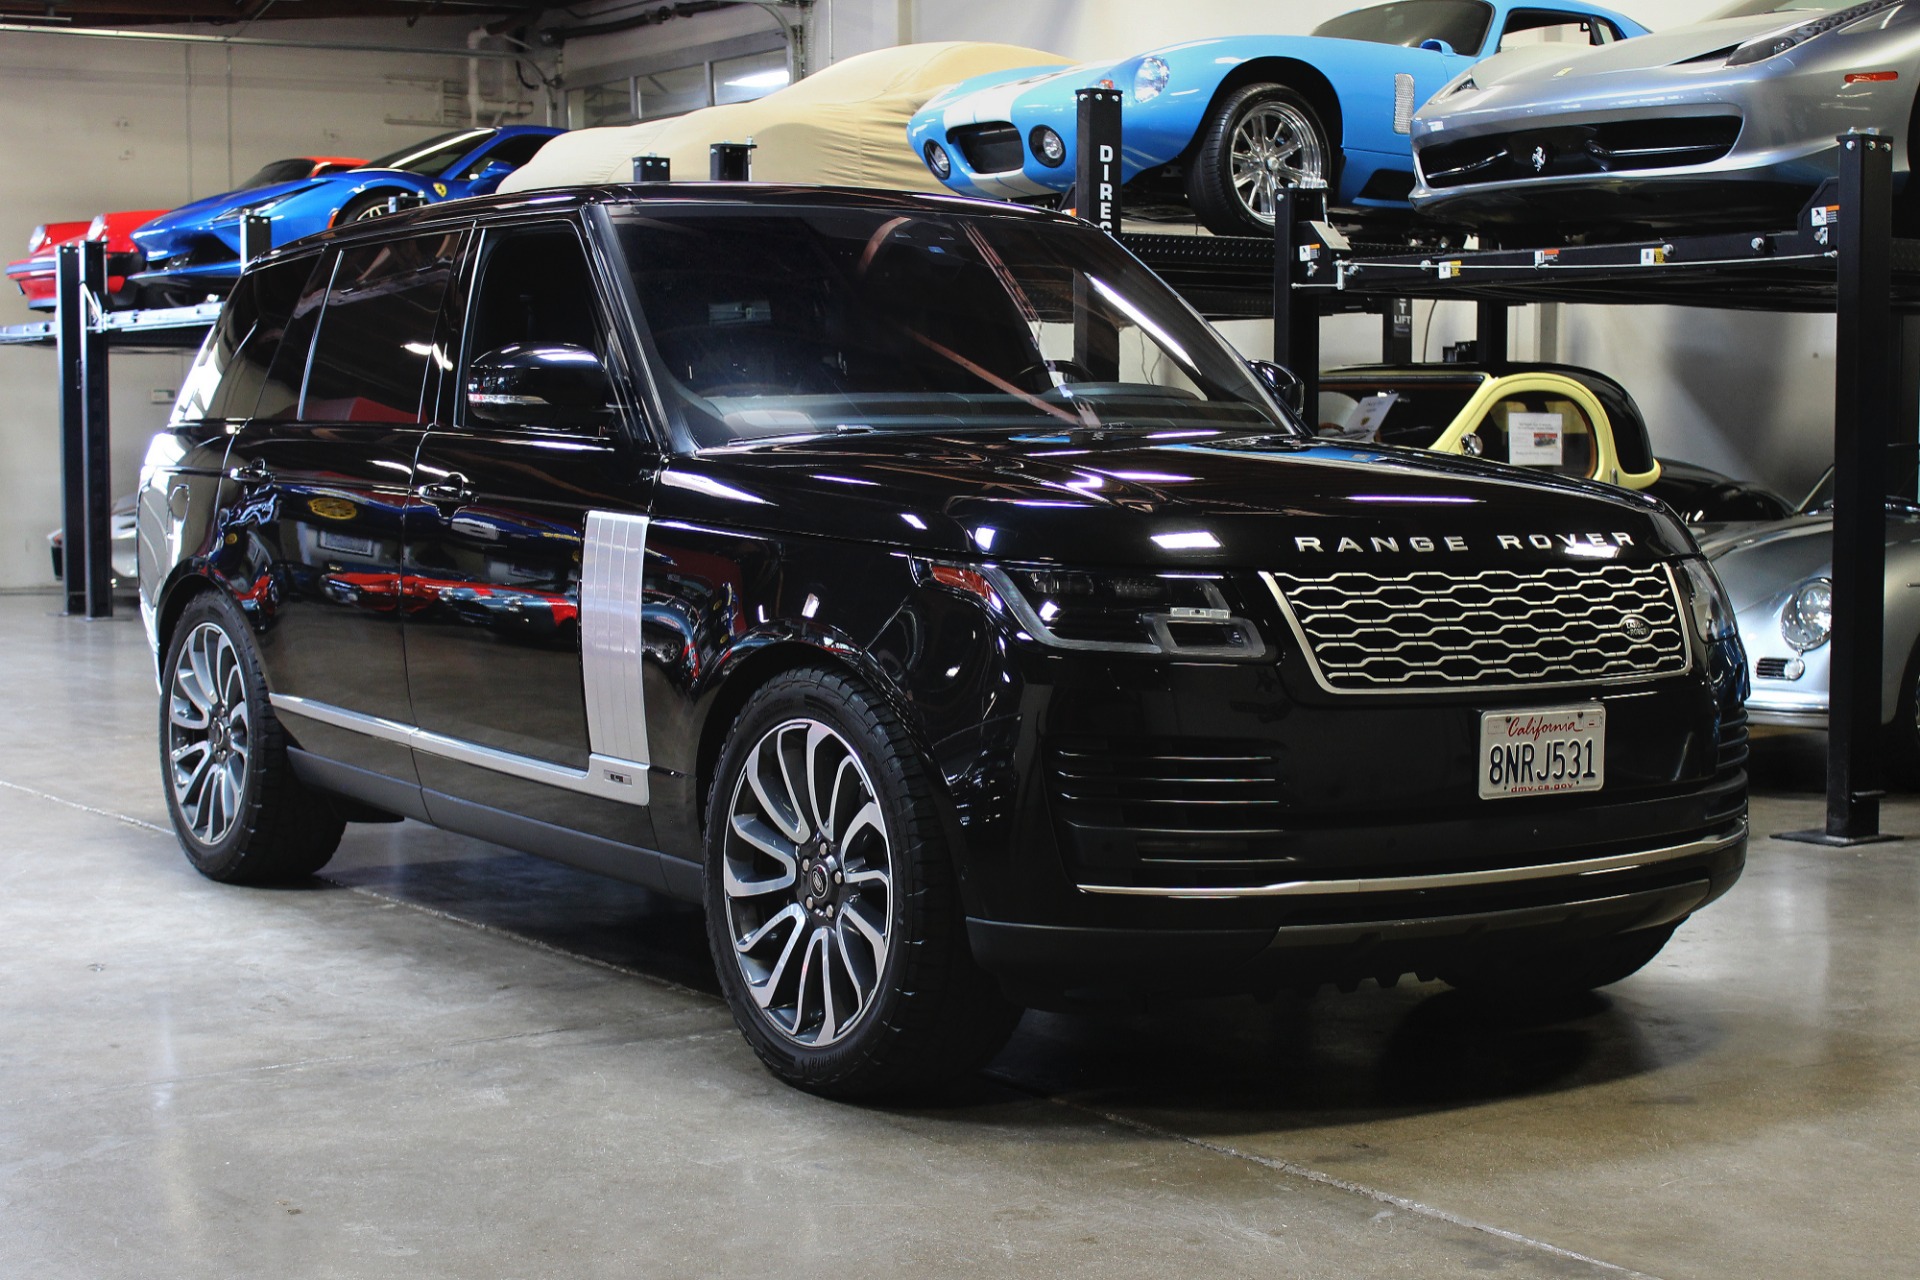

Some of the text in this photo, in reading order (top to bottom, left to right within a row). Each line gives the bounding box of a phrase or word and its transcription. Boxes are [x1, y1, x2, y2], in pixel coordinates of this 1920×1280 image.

[1394, 315, 1411, 324] LIFT
[1295, 532, 1635, 552] RANGE ROVER
[1508, 716, 1583, 741] California
[1489, 738, 1596, 785] 8NRJ531
[1511, 783, 1573, 793] dmv.ca.gov
